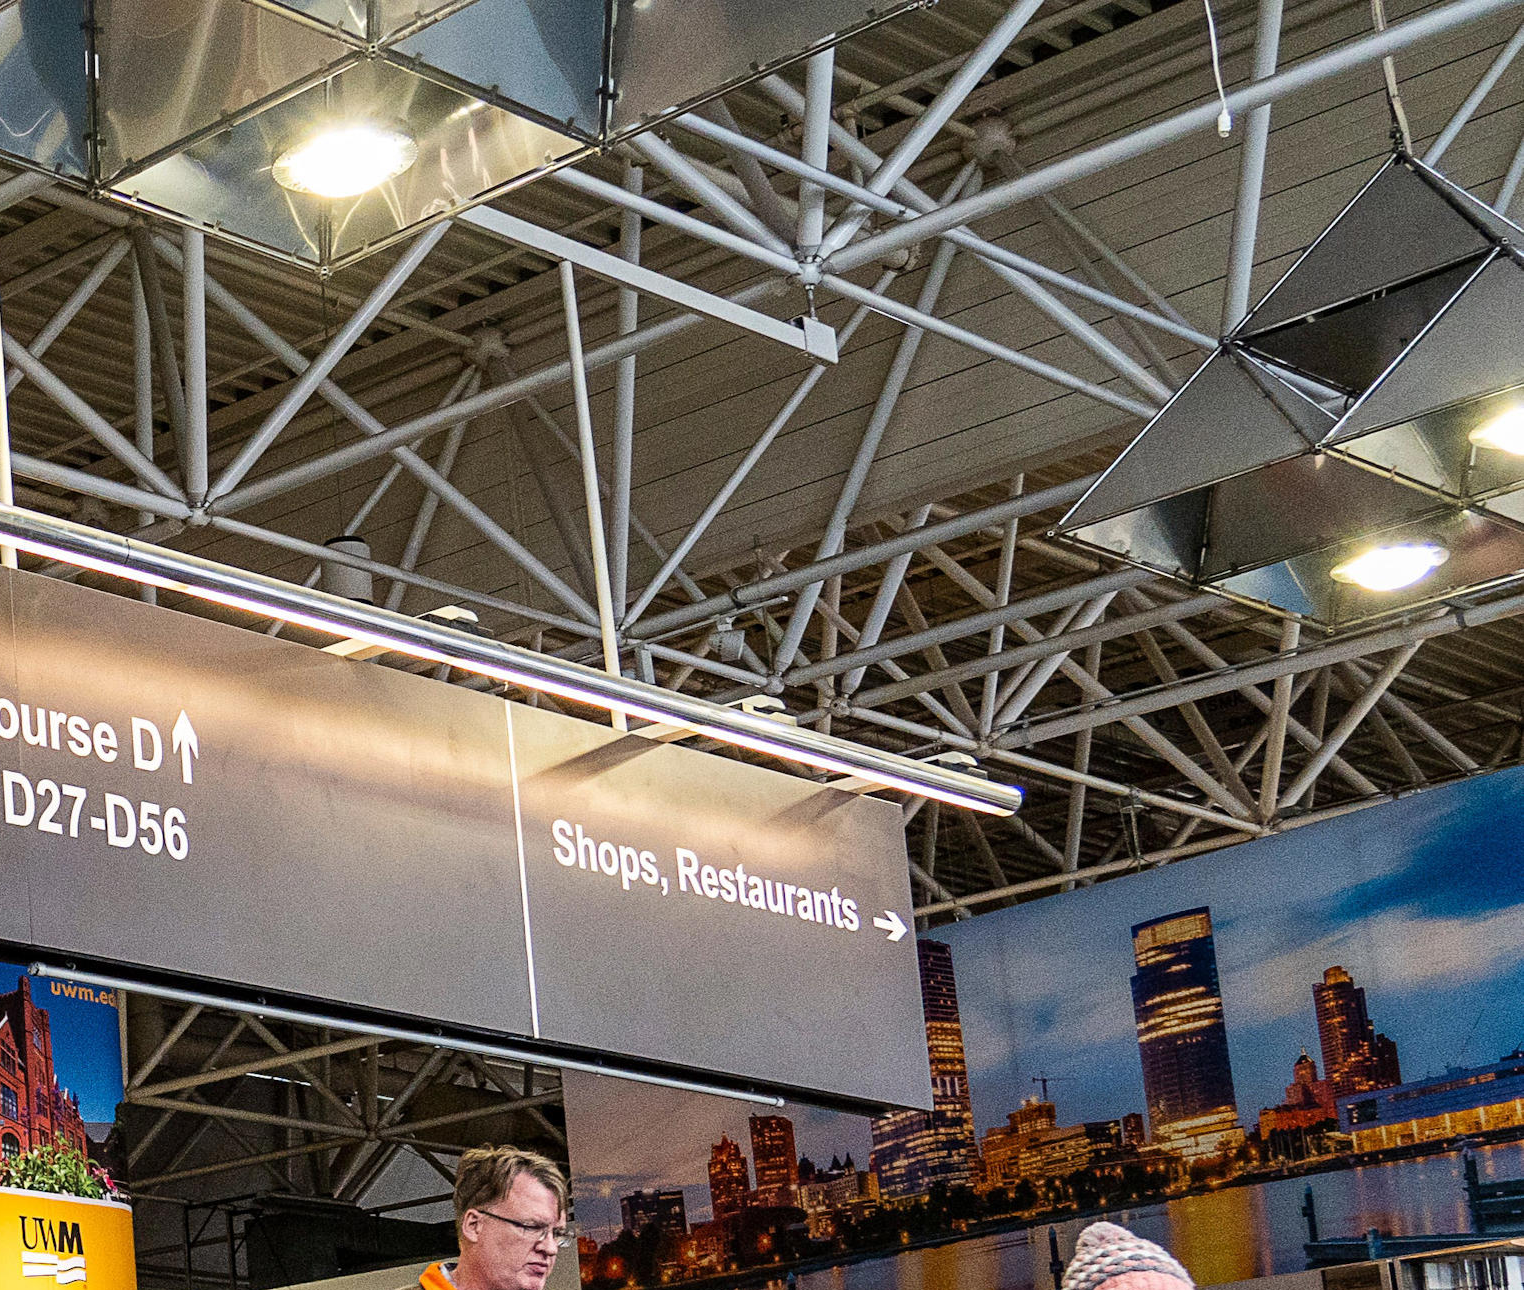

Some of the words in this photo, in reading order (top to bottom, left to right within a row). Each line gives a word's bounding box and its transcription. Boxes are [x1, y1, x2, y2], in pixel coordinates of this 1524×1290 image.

[130, 715, 165, 772] D
[2, 769, 190, 861] D27-D56
[551, 817, 671, 896] Shops,
[674, 845, 861, 932] Restaurants
[19, 1215, 84, 1256] UWM
